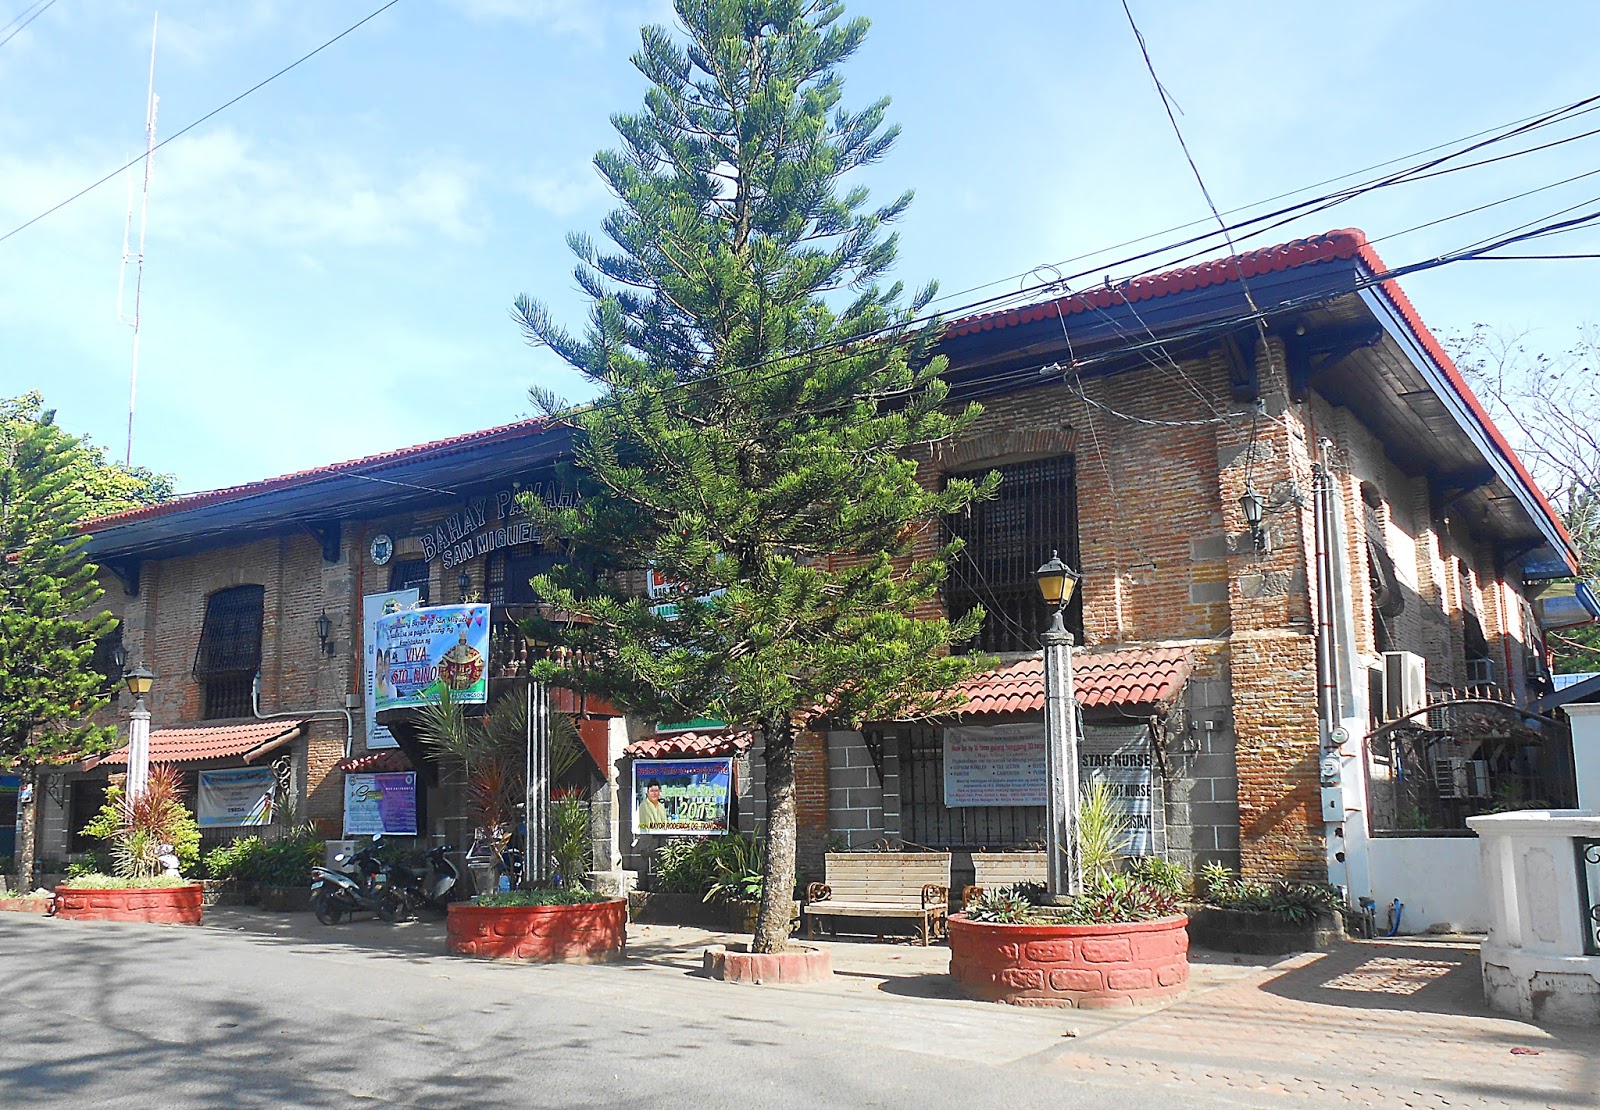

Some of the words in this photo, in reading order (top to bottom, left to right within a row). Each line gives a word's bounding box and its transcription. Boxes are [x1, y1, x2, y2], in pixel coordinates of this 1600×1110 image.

[420, 498, 487, 563] BAHAY
[441, 539, 474, 570] SAN
[435, 616, 446, 624] San
[406, 646, 427, 662] VIVA
[1082, 754, 1112, 767] STAFF
[1114, 753, 1151, 767] NURSE
[1125, 784, 1151, 797] NURSE
[680, 802, 715, 819] 2015
[649, 822, 665, 830] MAYOR
